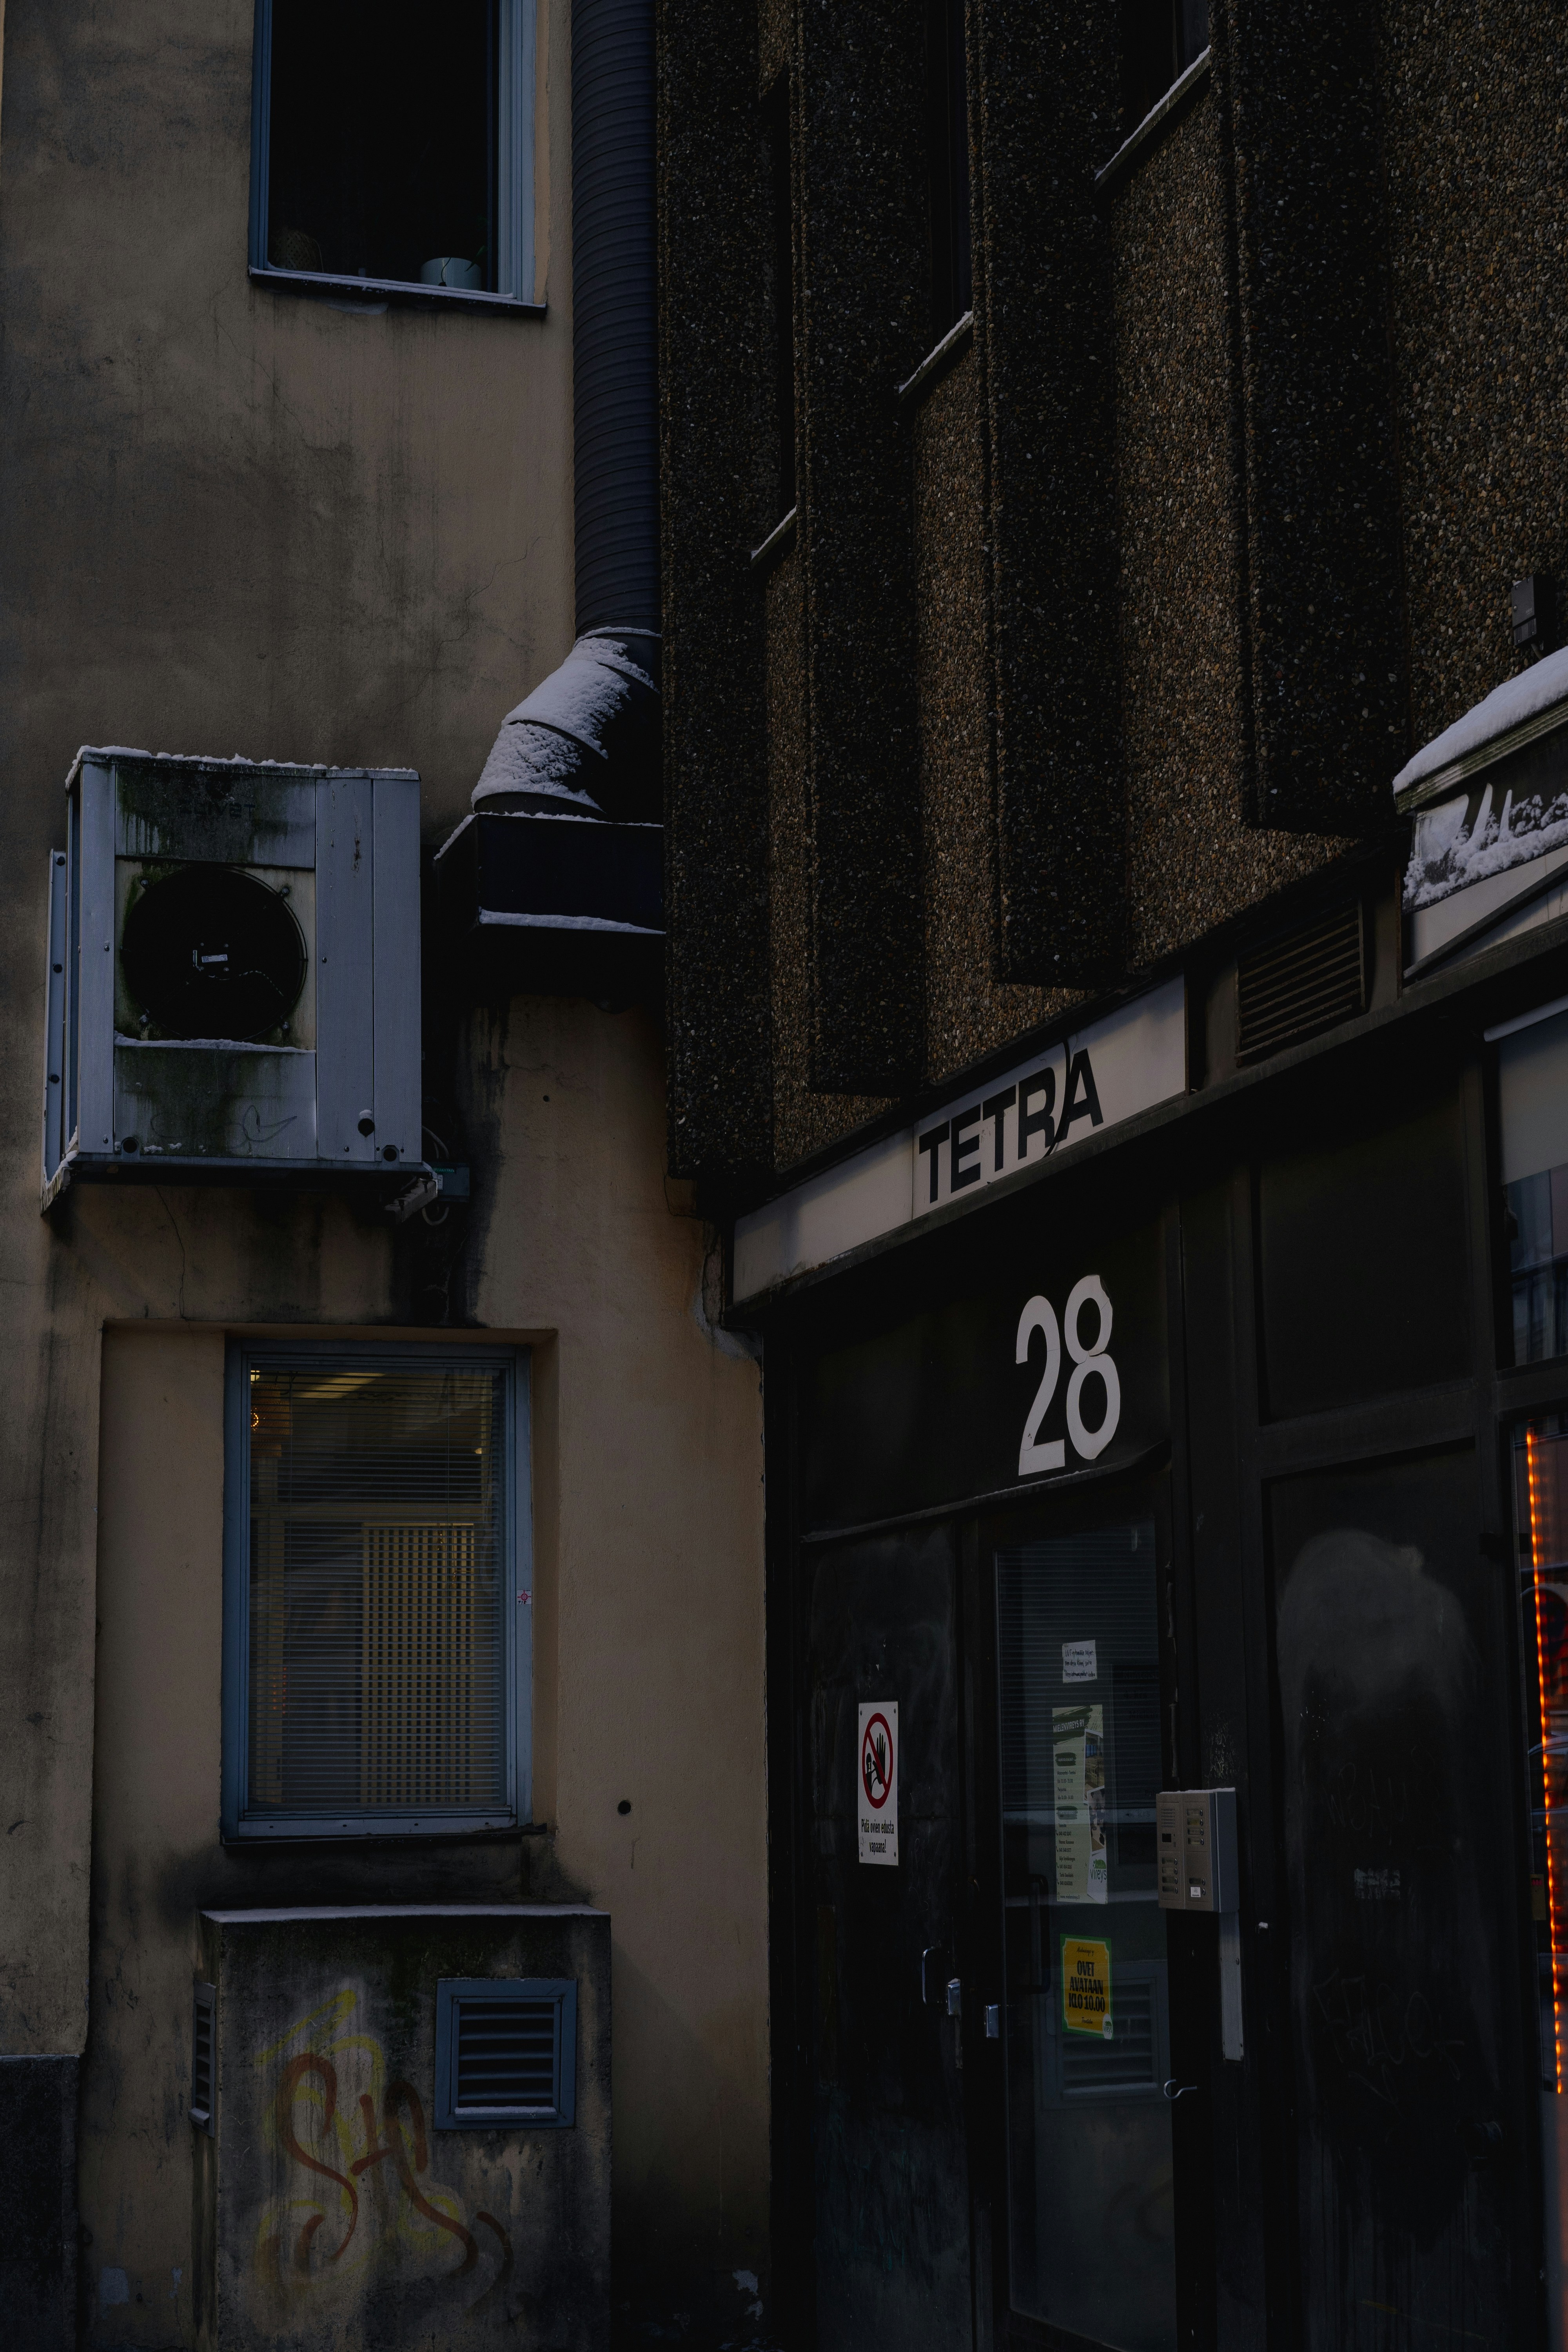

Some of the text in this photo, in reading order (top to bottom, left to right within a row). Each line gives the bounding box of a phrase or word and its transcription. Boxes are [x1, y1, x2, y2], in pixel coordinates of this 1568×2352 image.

[919, 1048, 1103, 1203] TETRA
[1016, 1275, 1120, 1475] 28
[1053, 1719, 1084, 1733] MIELENVIREYS RY
[861, 1818, 894, 1834] Pidä ovien edusta
[869, 1838, 886, 1855] vapaana!
[1090, 1867, 1107, 1883] vireys
[1077, 1960, 1095, 1976] OVET
[1070, 1976, 1103, 1995] AVATAAN
[1069, 1993, 1105, 2012] KLO 10.00
